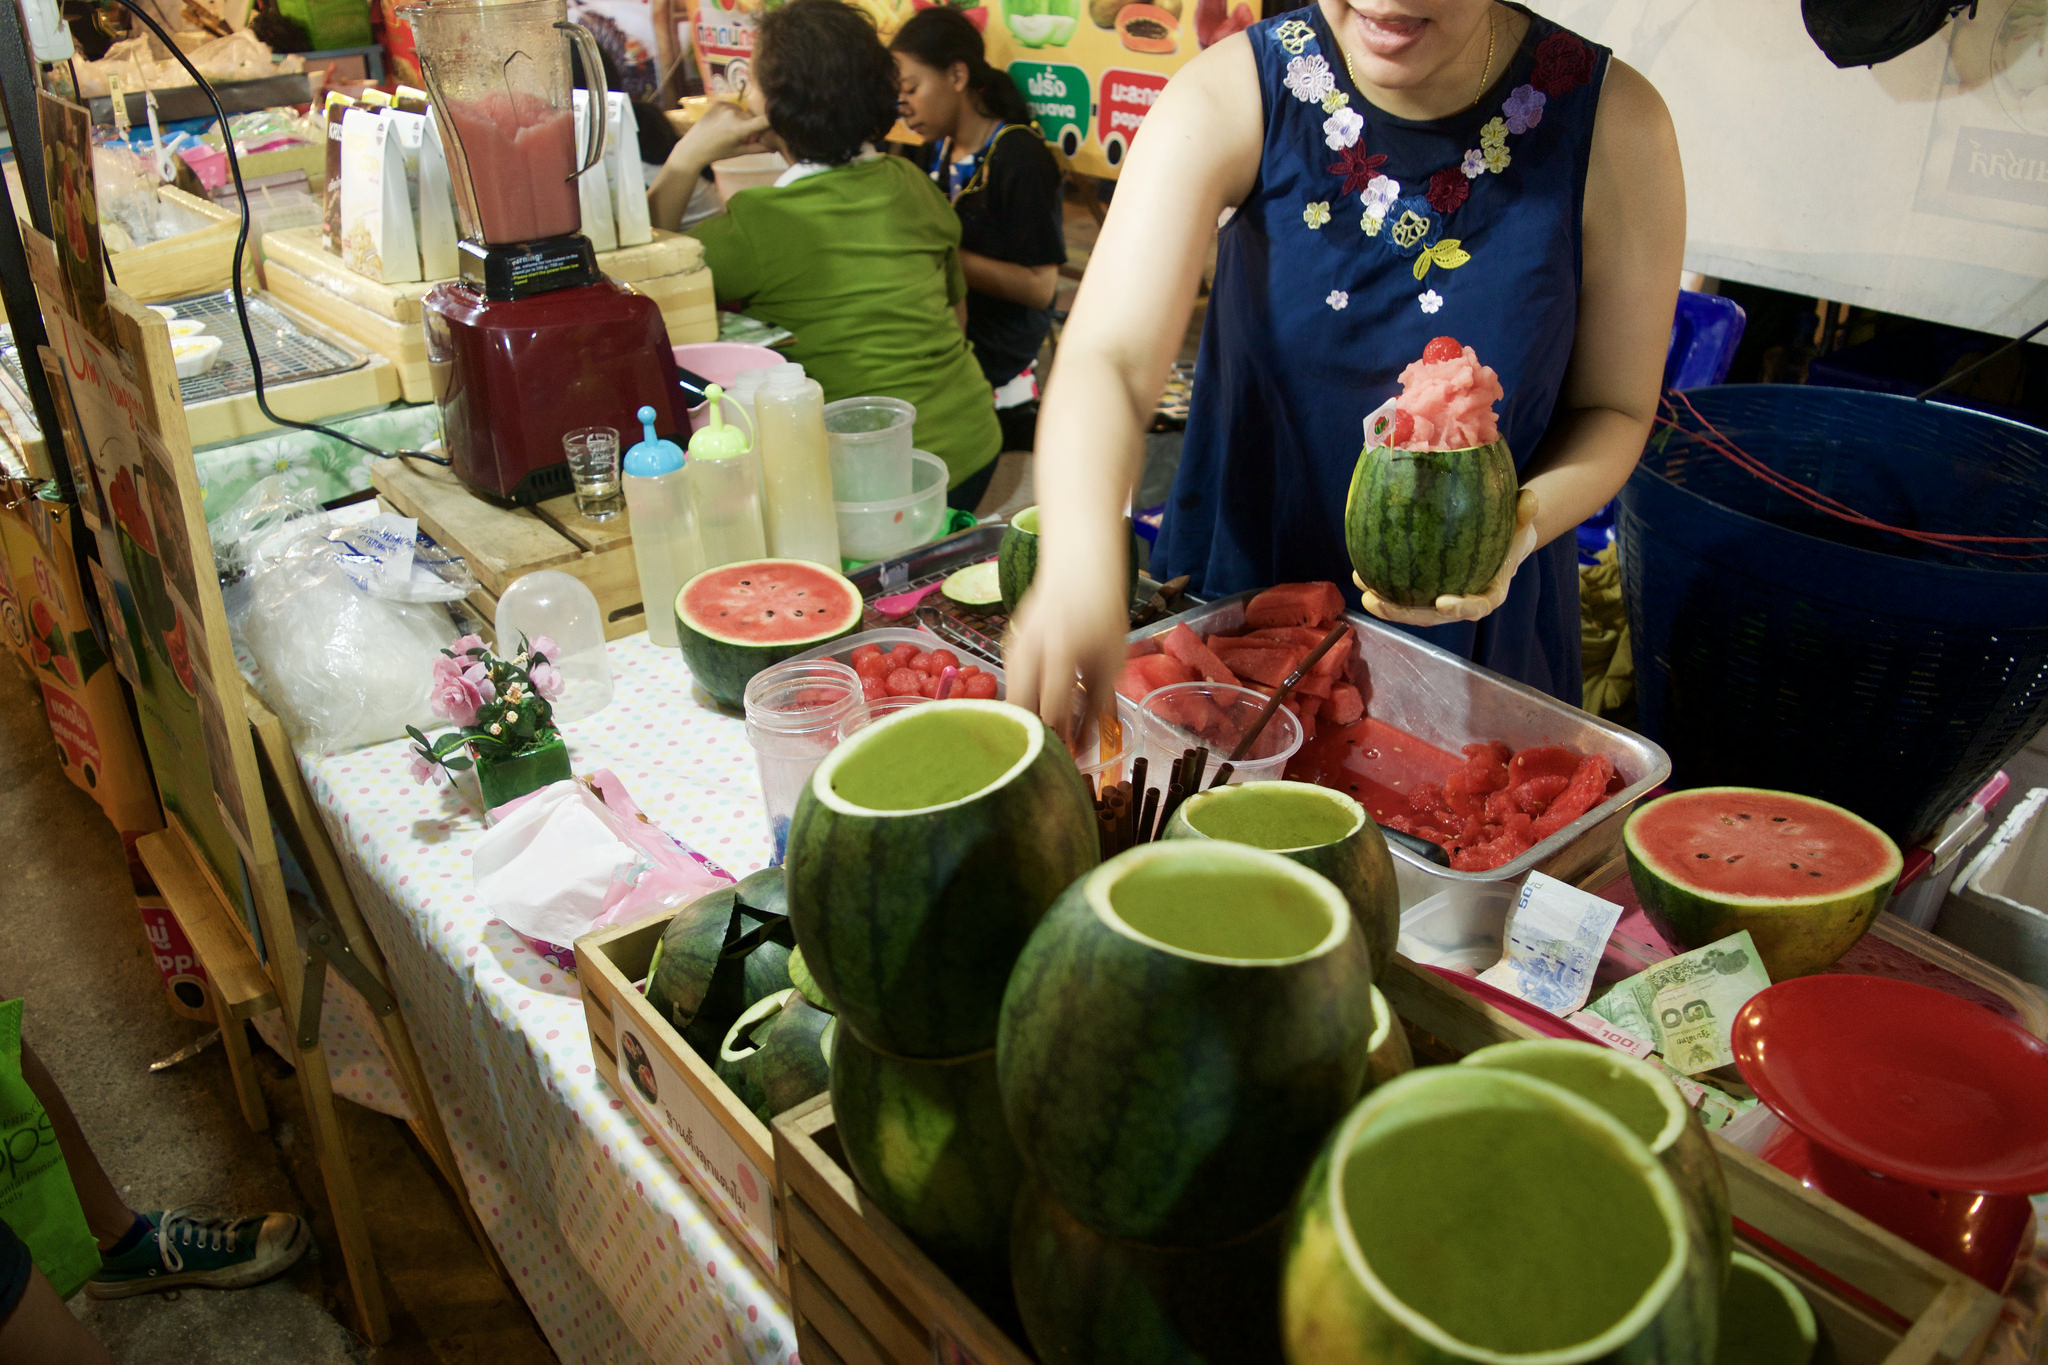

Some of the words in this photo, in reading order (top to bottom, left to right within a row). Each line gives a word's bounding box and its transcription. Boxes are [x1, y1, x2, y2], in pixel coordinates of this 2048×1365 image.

[1028, 65, 1067, 97] ฝรั่ง
[1517, 886, 1534, 910] 50
[1602, 1030, 1635, 1048] 100
